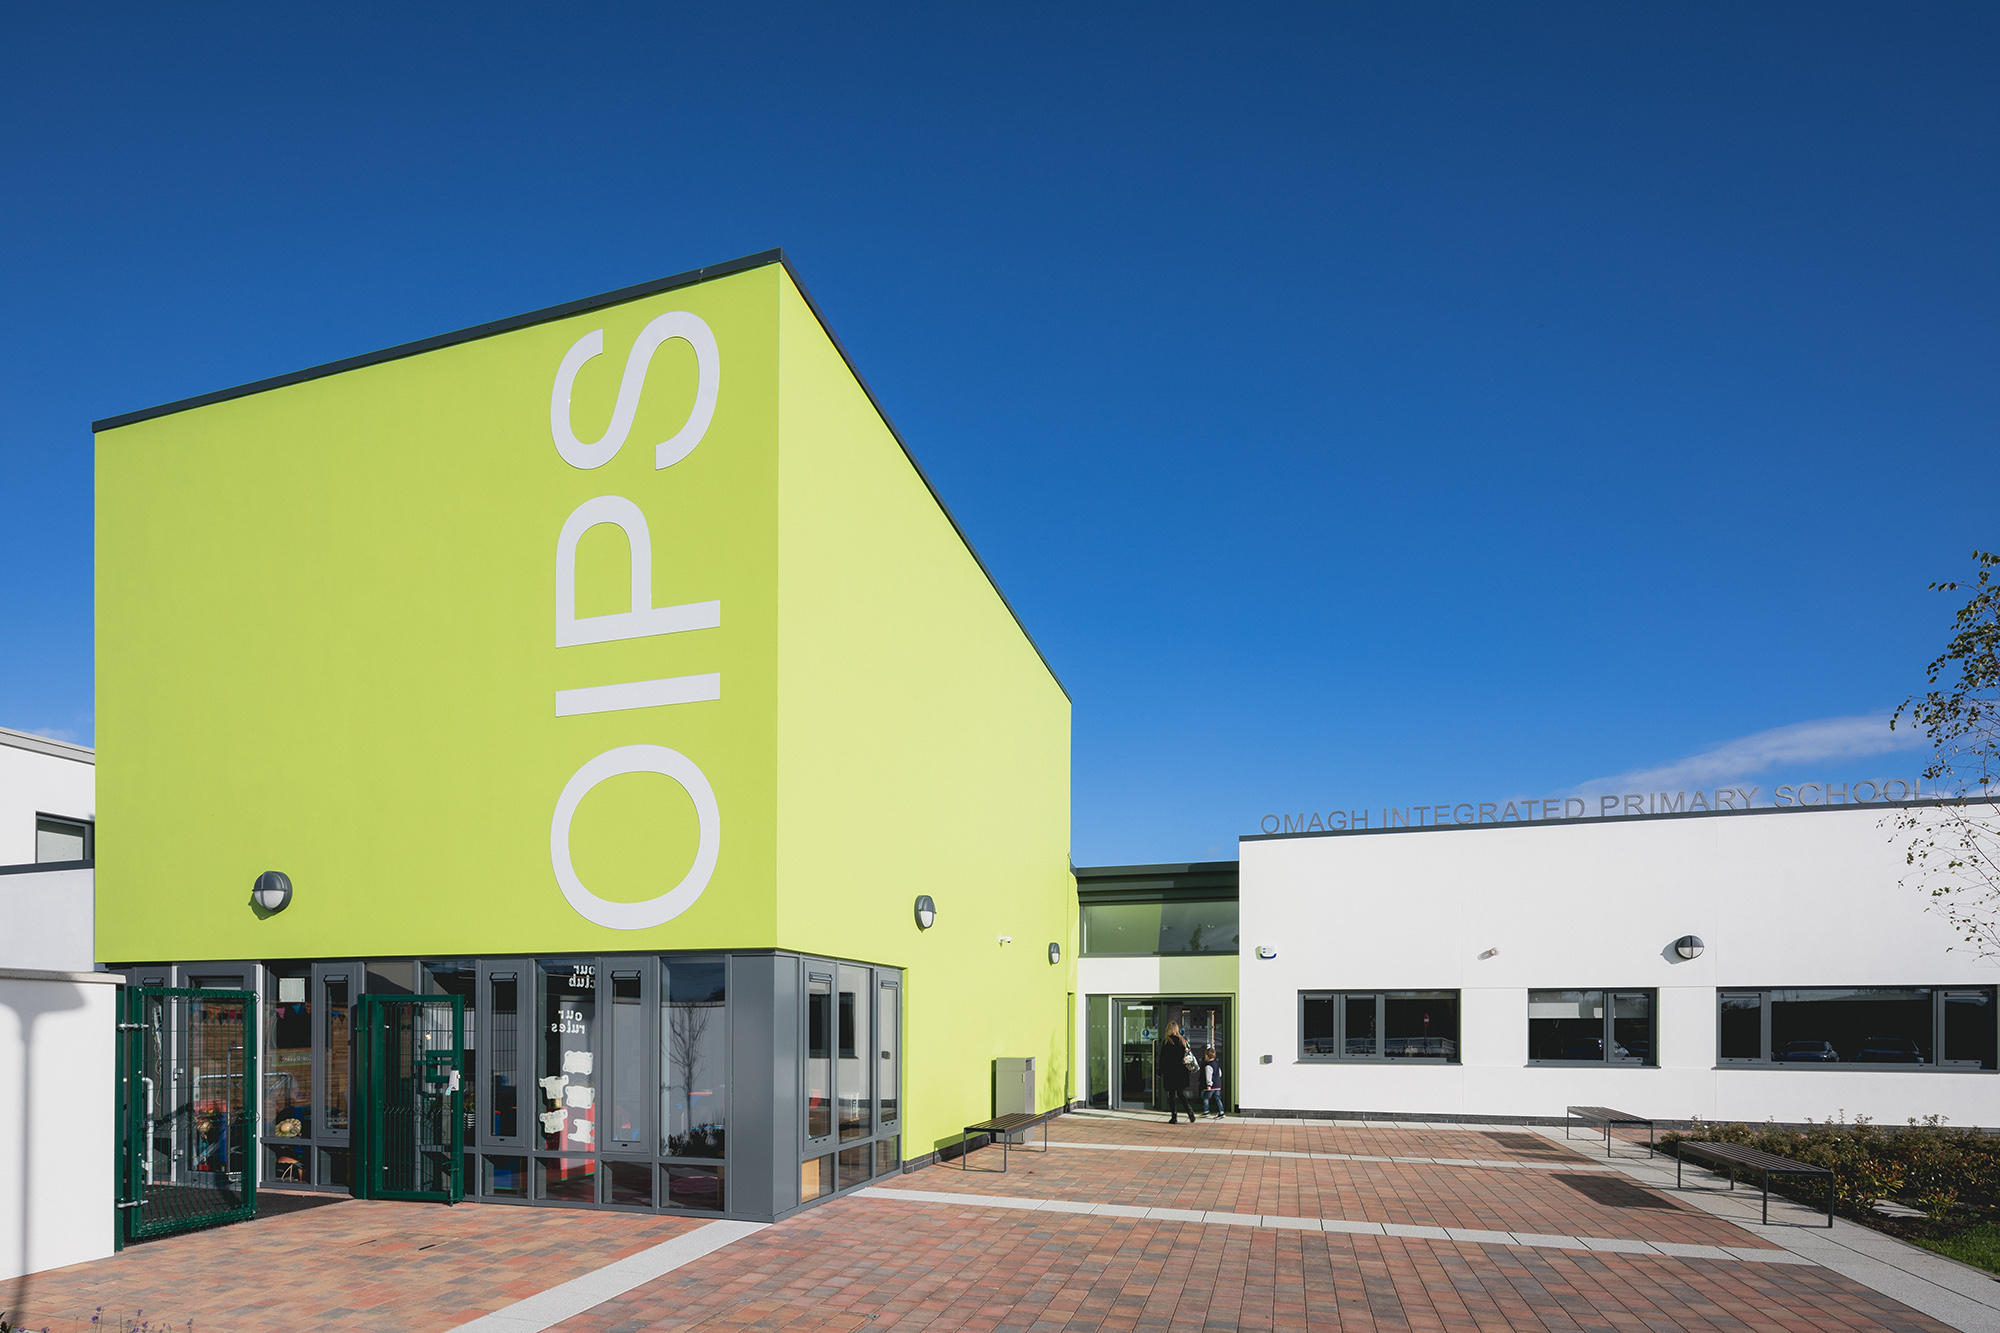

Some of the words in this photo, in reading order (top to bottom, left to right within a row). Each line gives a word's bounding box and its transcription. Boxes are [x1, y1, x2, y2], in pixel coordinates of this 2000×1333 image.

[550, 310, 720, 930] OIPS
[1260, 809, 1369, 834] OMAGH
[1383, 798, 1585, 828] INTEGRATED
[1600, 787, 1760, 817] PRIMARY
[1774, 778, 1933, 808] SCHOOL
